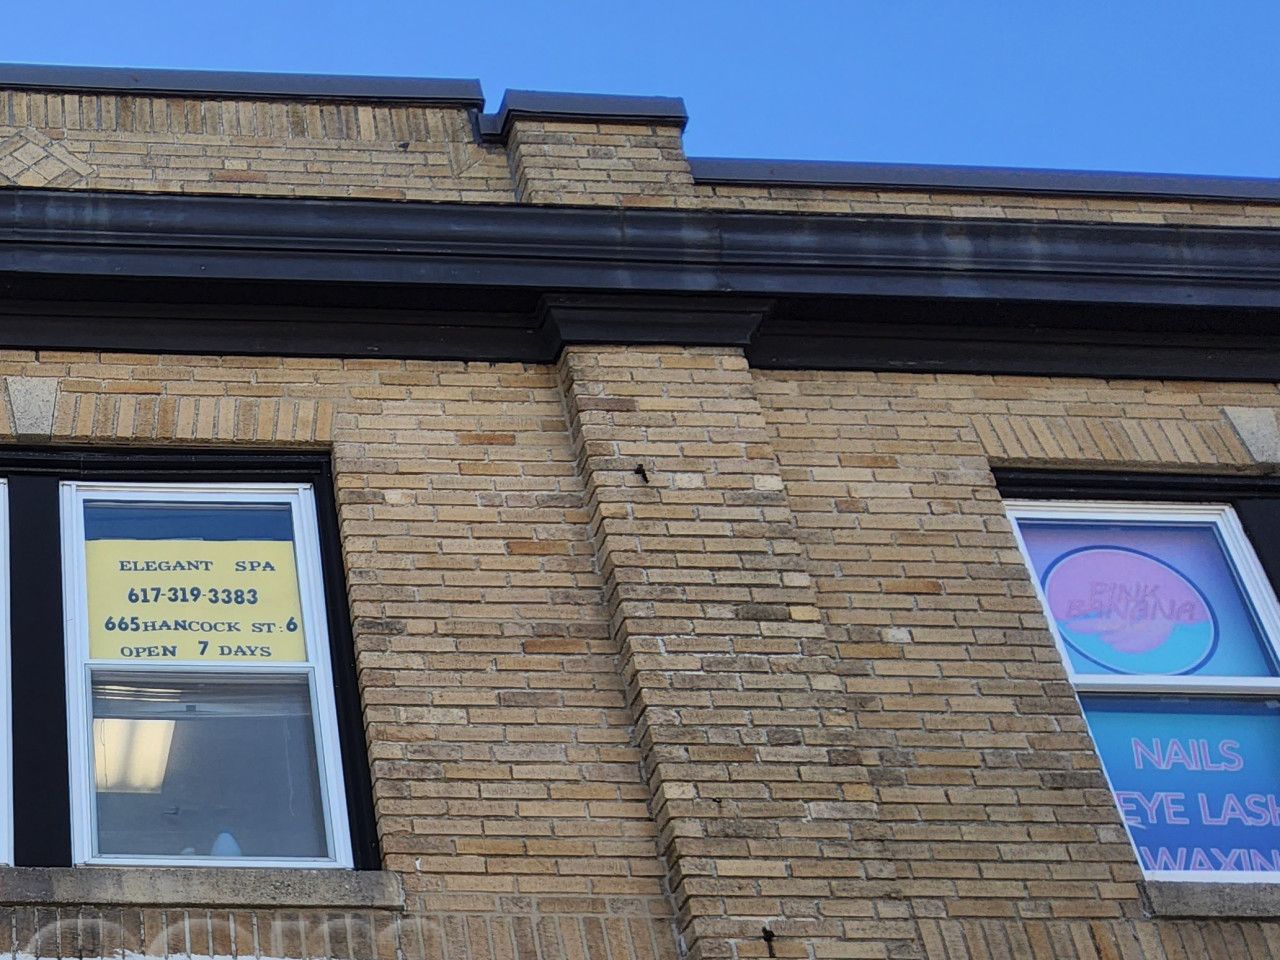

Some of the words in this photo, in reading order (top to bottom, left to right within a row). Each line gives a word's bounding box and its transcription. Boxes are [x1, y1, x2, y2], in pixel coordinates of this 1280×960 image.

[119, 560, 213, 571] ELEGANT
[234, 560, 275, 572] SPA
[127, 586, 259, 605] 617-319-3383
[1088, 581, 1161, 602] PINK
[120, 645, 177, 657] OPEN
[198, 640, 209, 656] 7
[219, 645, 272, 656] DAYS
[1131, 737, 1244, 771] NAILS
[1115, 790, 1190, 826] EYE
